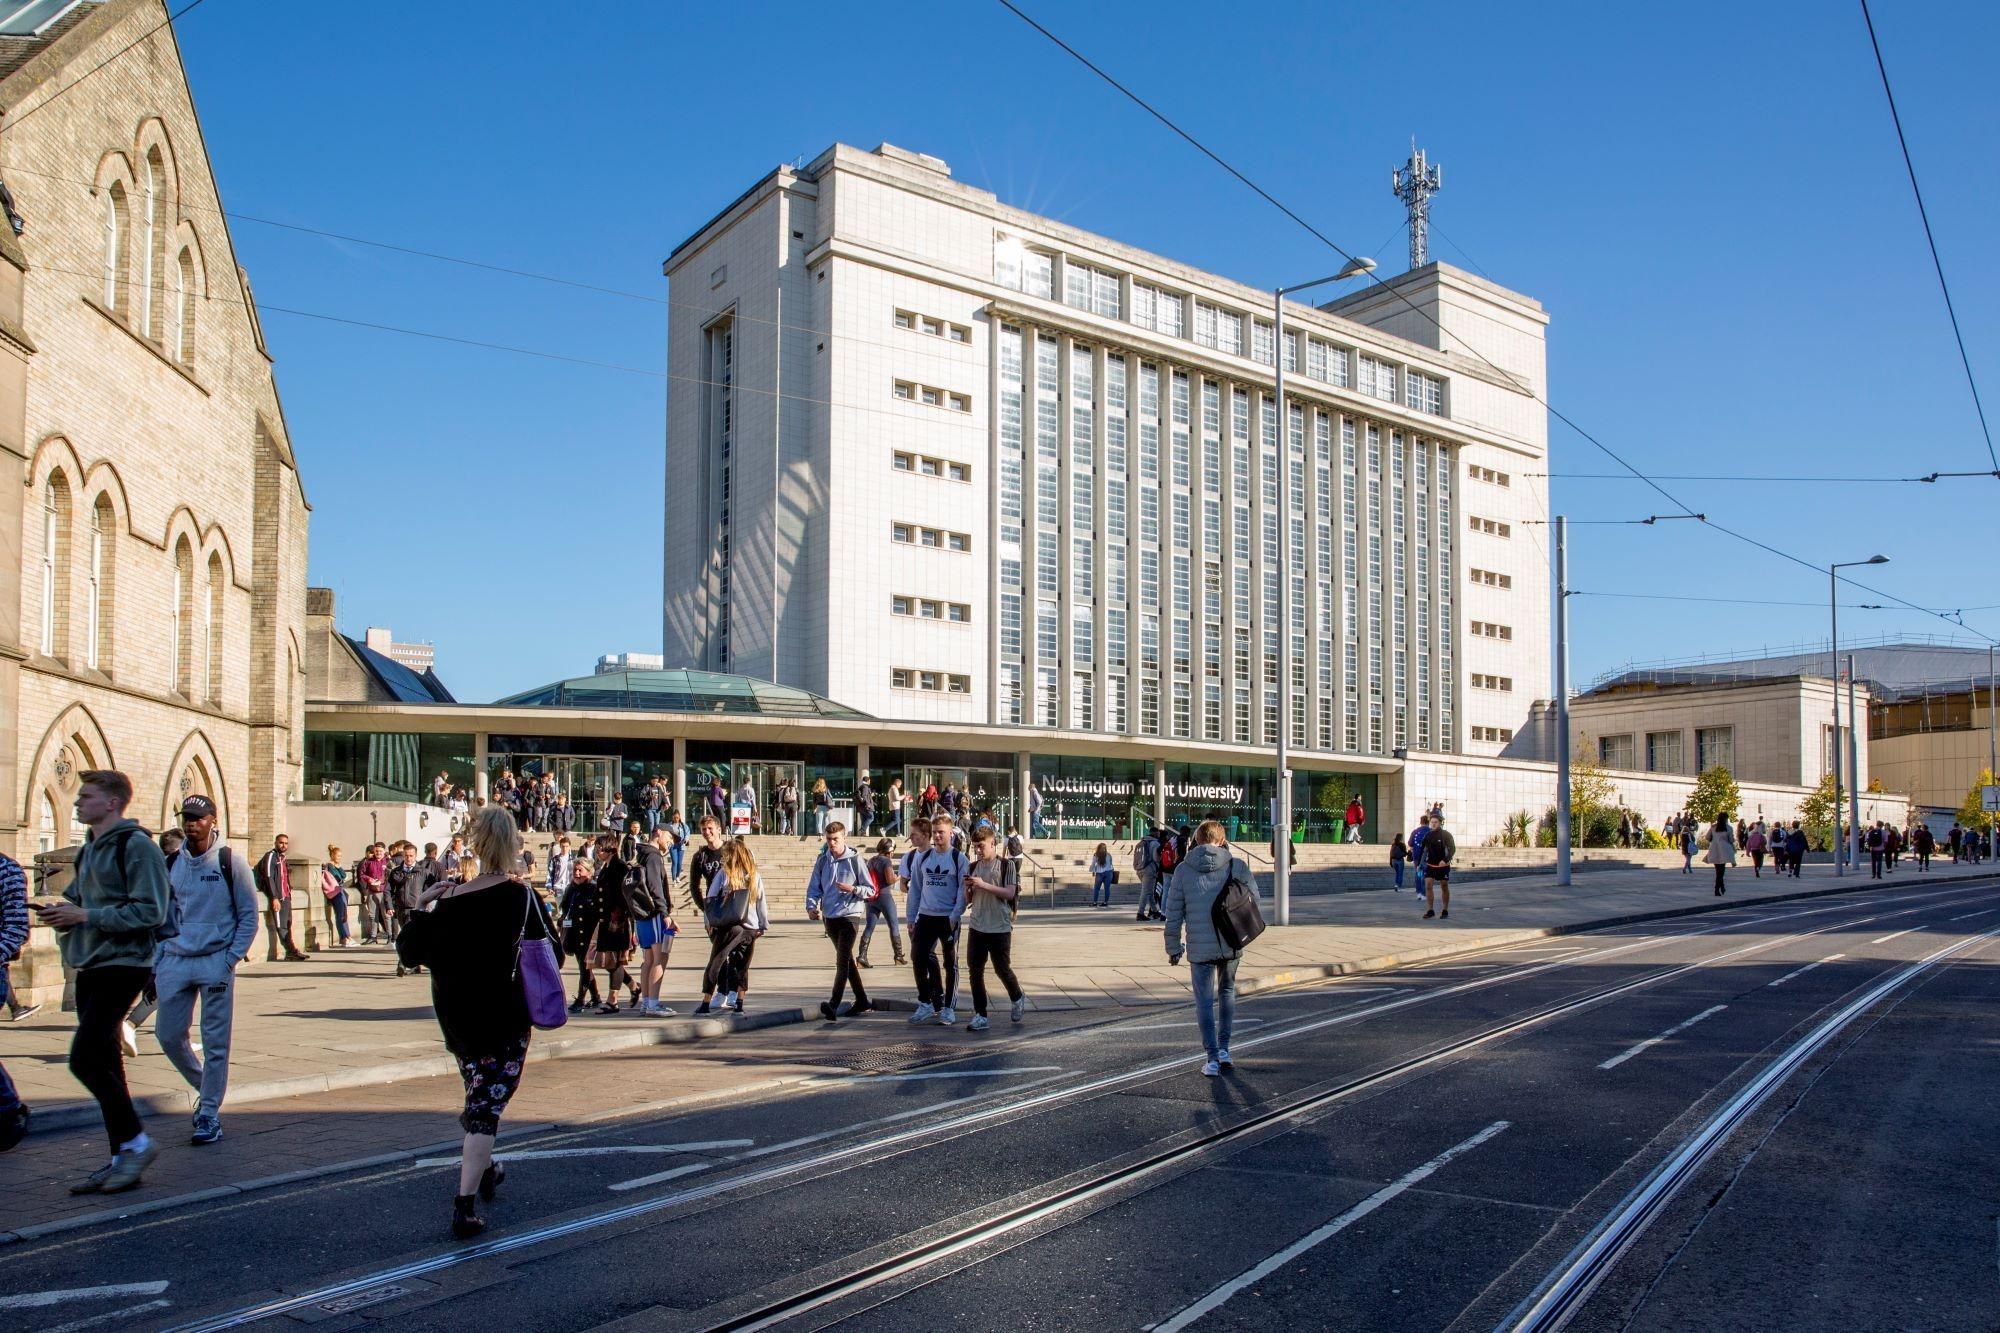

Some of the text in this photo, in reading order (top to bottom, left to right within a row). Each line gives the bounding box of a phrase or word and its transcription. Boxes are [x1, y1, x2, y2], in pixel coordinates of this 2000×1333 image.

[1042, 774, 1134, 798] Nottingham
[1178, 781, 1243, 803] University
[1042, 817, 1106, 828] Newon & Arkwright
